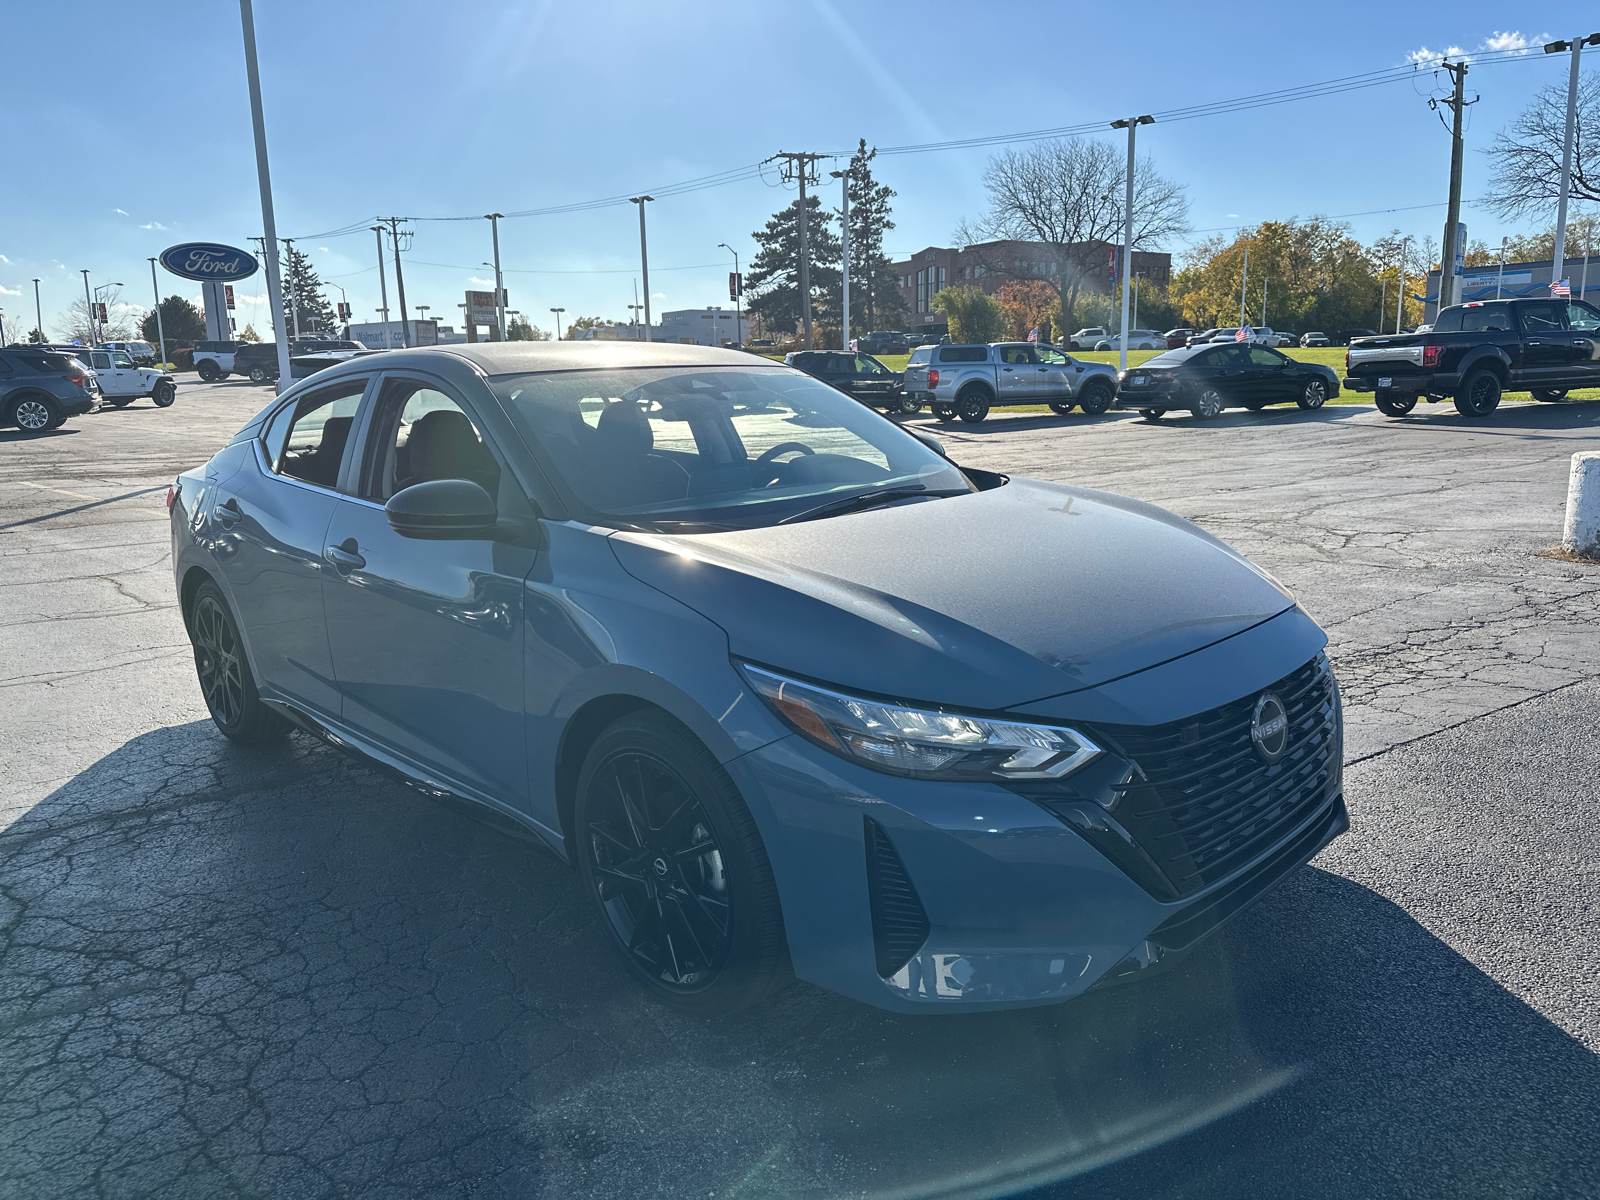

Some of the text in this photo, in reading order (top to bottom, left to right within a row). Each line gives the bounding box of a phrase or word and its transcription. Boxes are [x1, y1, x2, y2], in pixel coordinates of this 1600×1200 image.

[185, 250, 239, 273] Ford
[356, 331, 383, 342] Walmart
[1254, 716, 1286, 739] NISSAN
